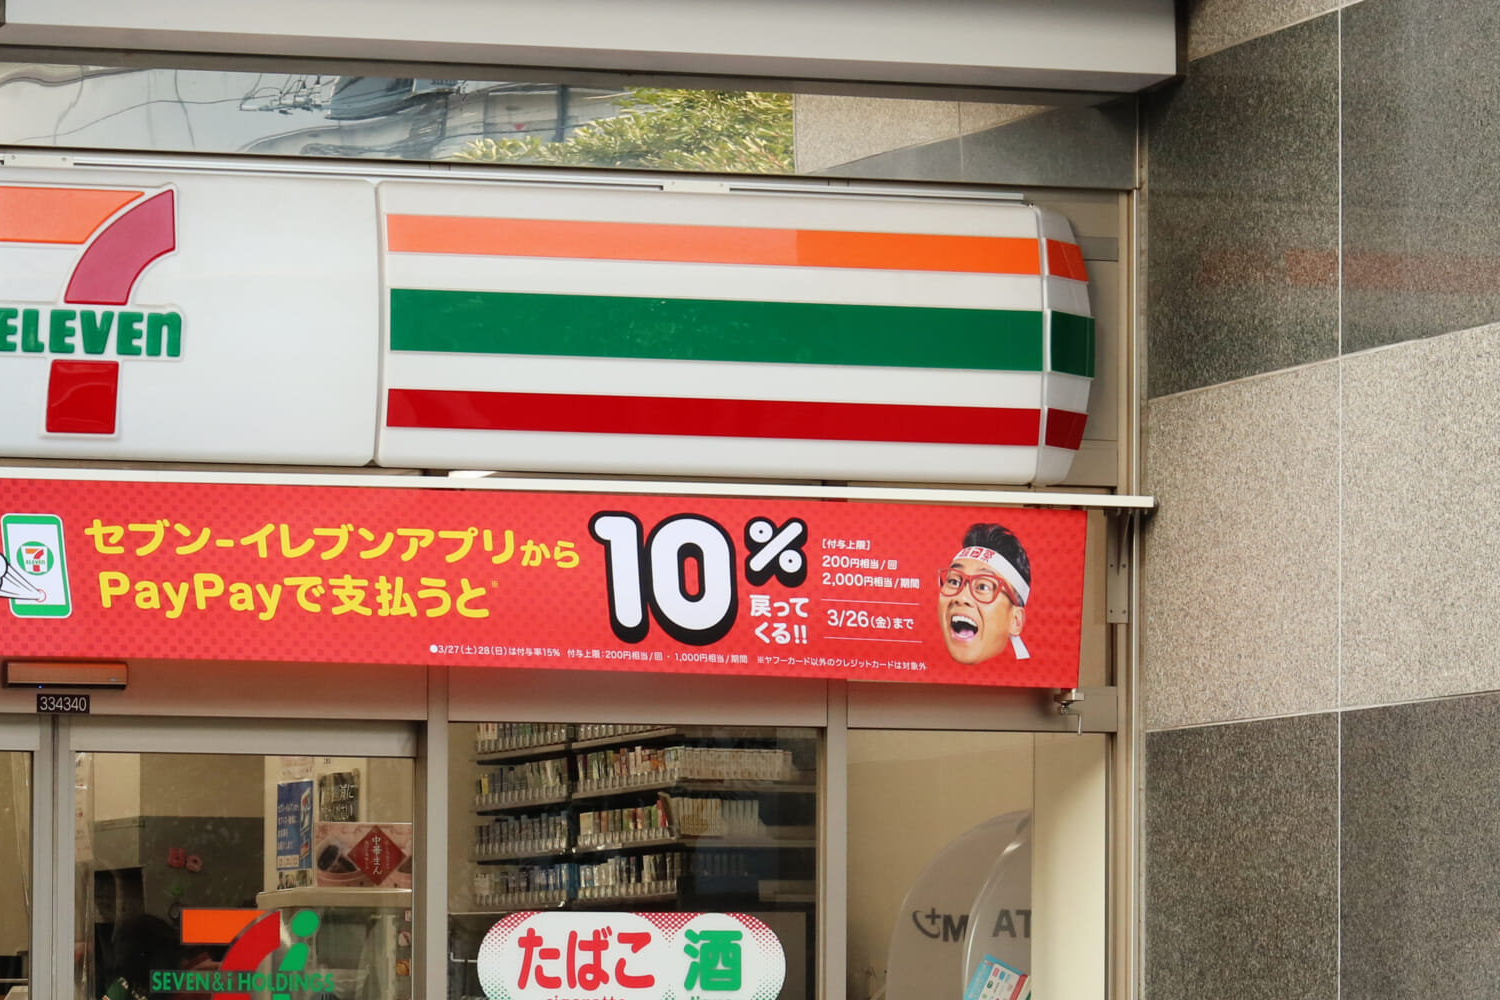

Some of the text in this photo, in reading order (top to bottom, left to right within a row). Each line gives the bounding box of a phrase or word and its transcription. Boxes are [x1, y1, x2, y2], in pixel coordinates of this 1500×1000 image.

[588, 510, 809, 646] 10%
[98, 571, 490, 621] PayPayで支払うと
[749, 594, 810, 617] 戻って
[754, 620, 808, 645] くる!!
[38, 695, 87, 713] 334340
[517, 925, 743, 992] たばこ 酒
[238, 972, 336, 993] HOLDINGS
